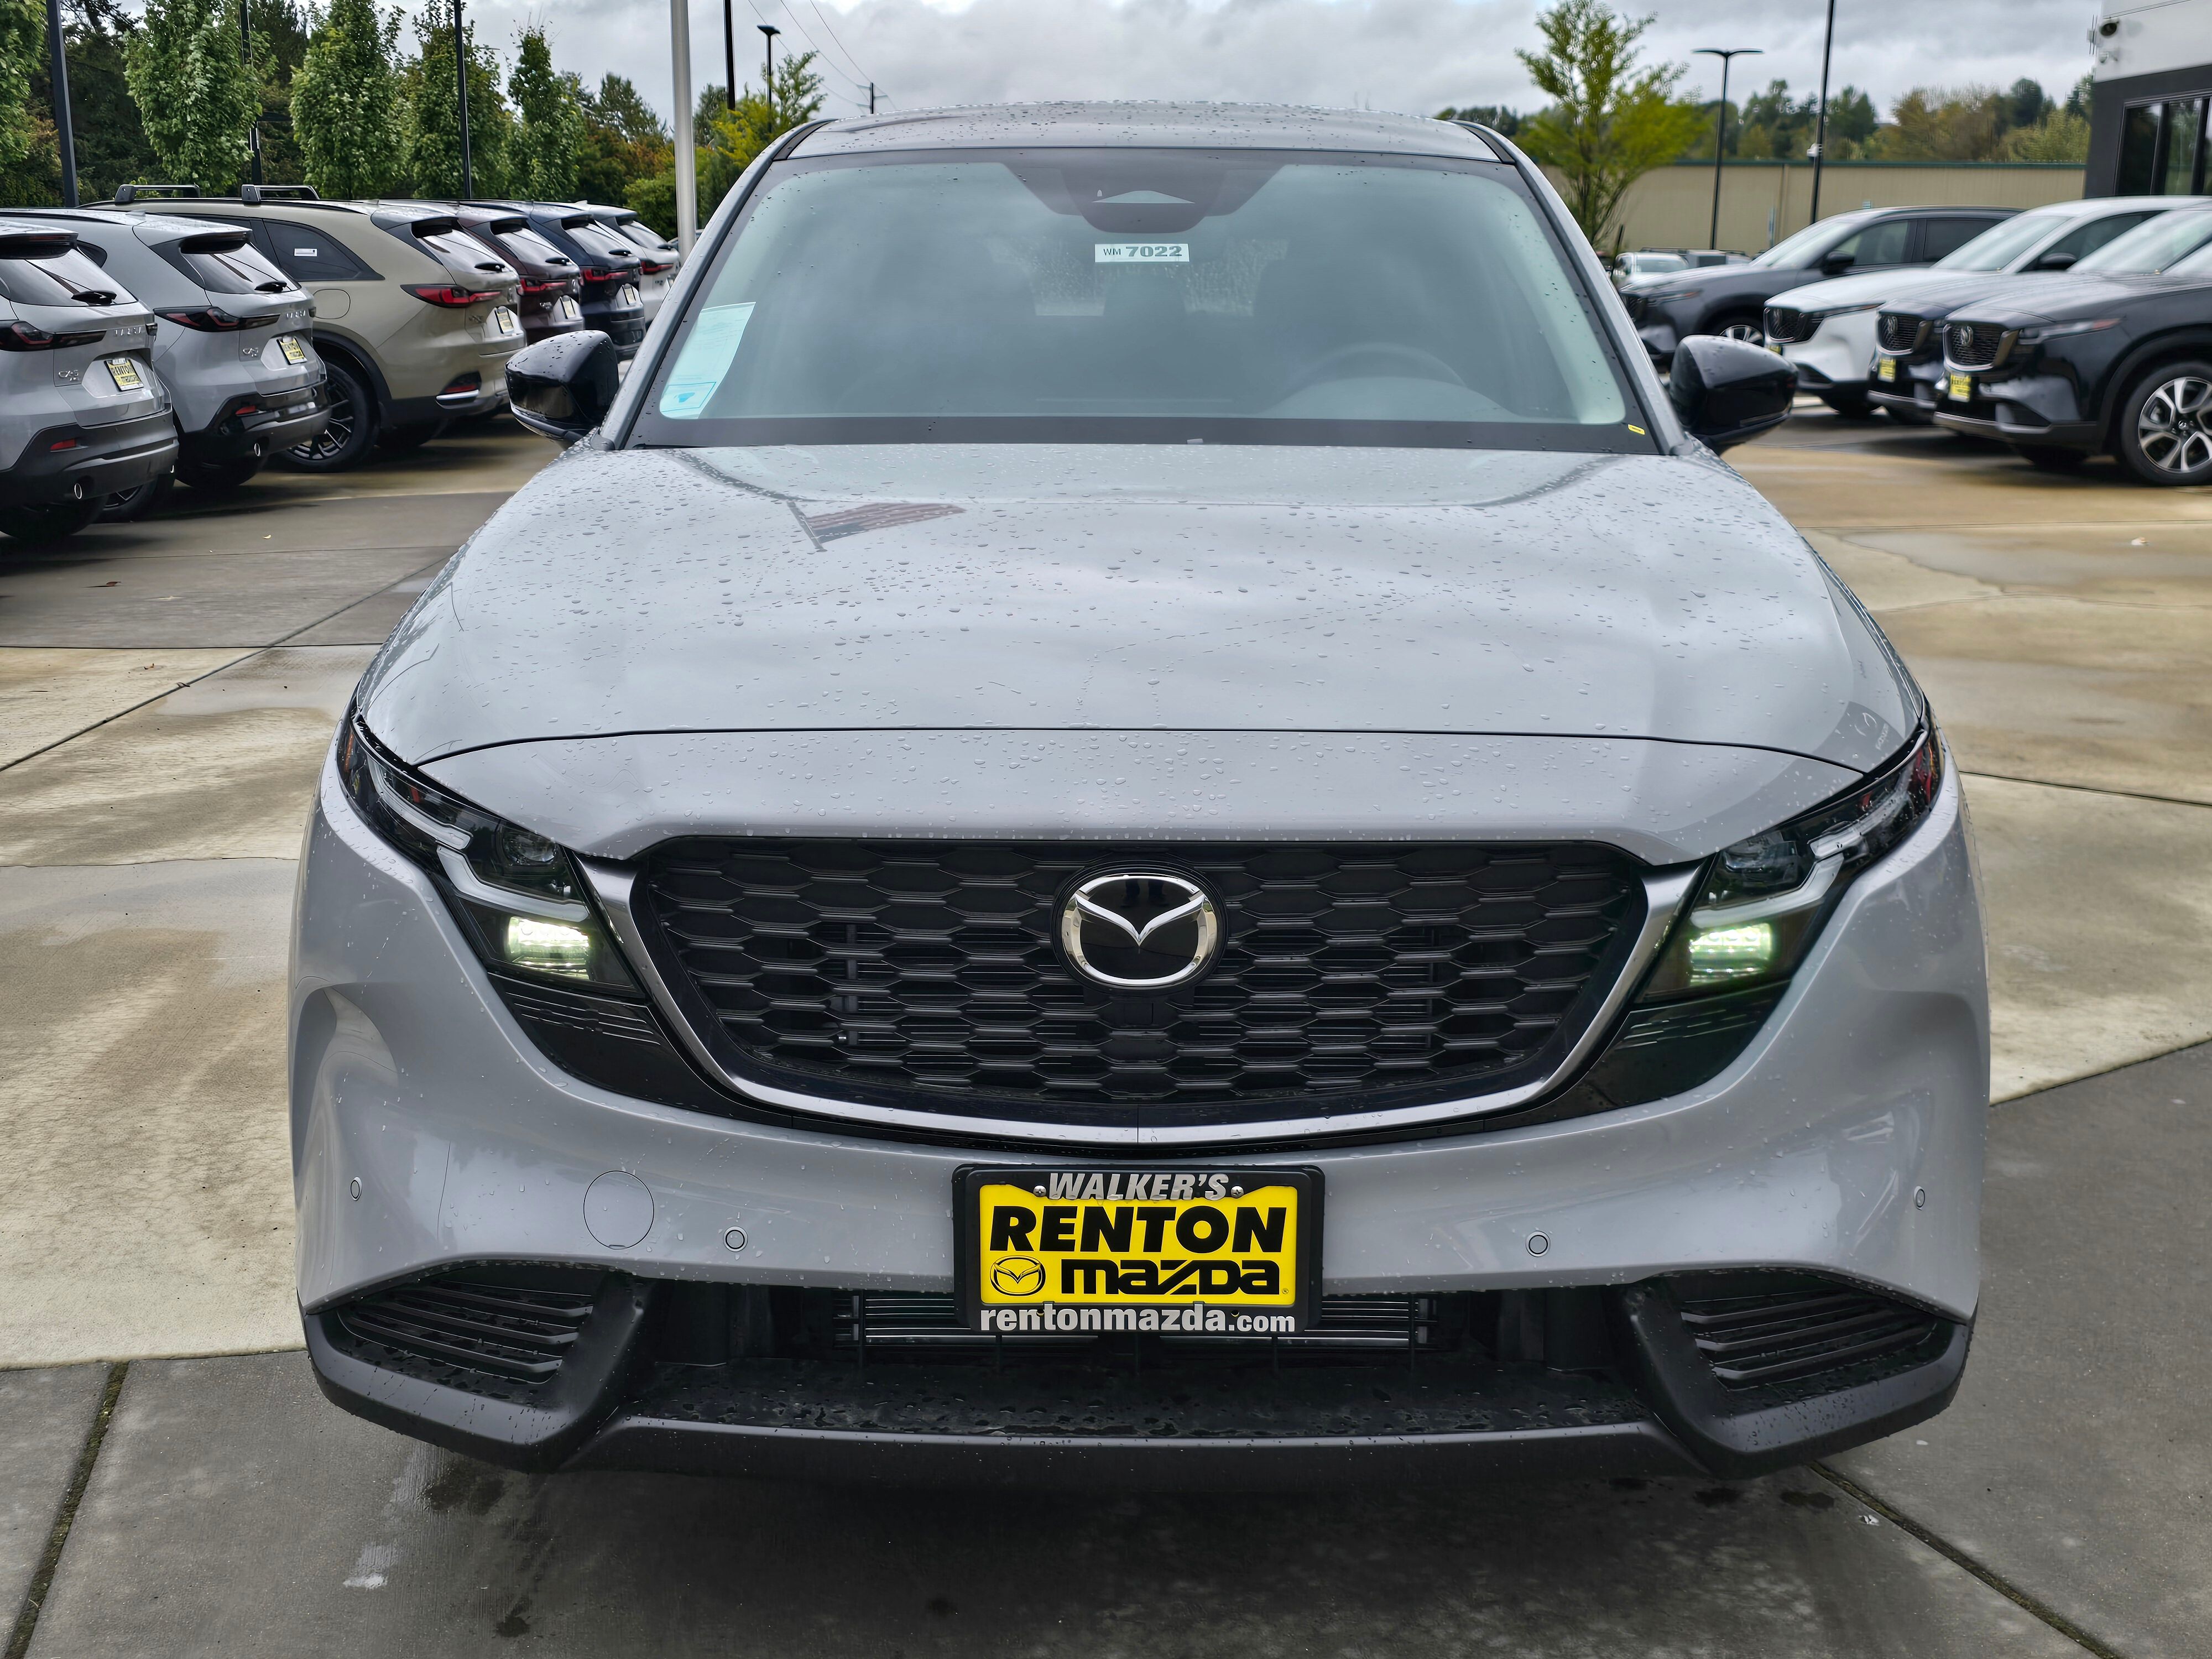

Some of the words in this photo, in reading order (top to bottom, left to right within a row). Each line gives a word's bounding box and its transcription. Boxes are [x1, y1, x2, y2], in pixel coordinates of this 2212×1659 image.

[1126, 246, 1182, 257] 7022
[1049, 1172, 1229, 1201] WALKER'S
[990, 1205, 1287, 1254] RENTON
[1061, 1259, 1280, 1296] mazda
[980, 1303, 1295, 1332] rentonmazda.com
